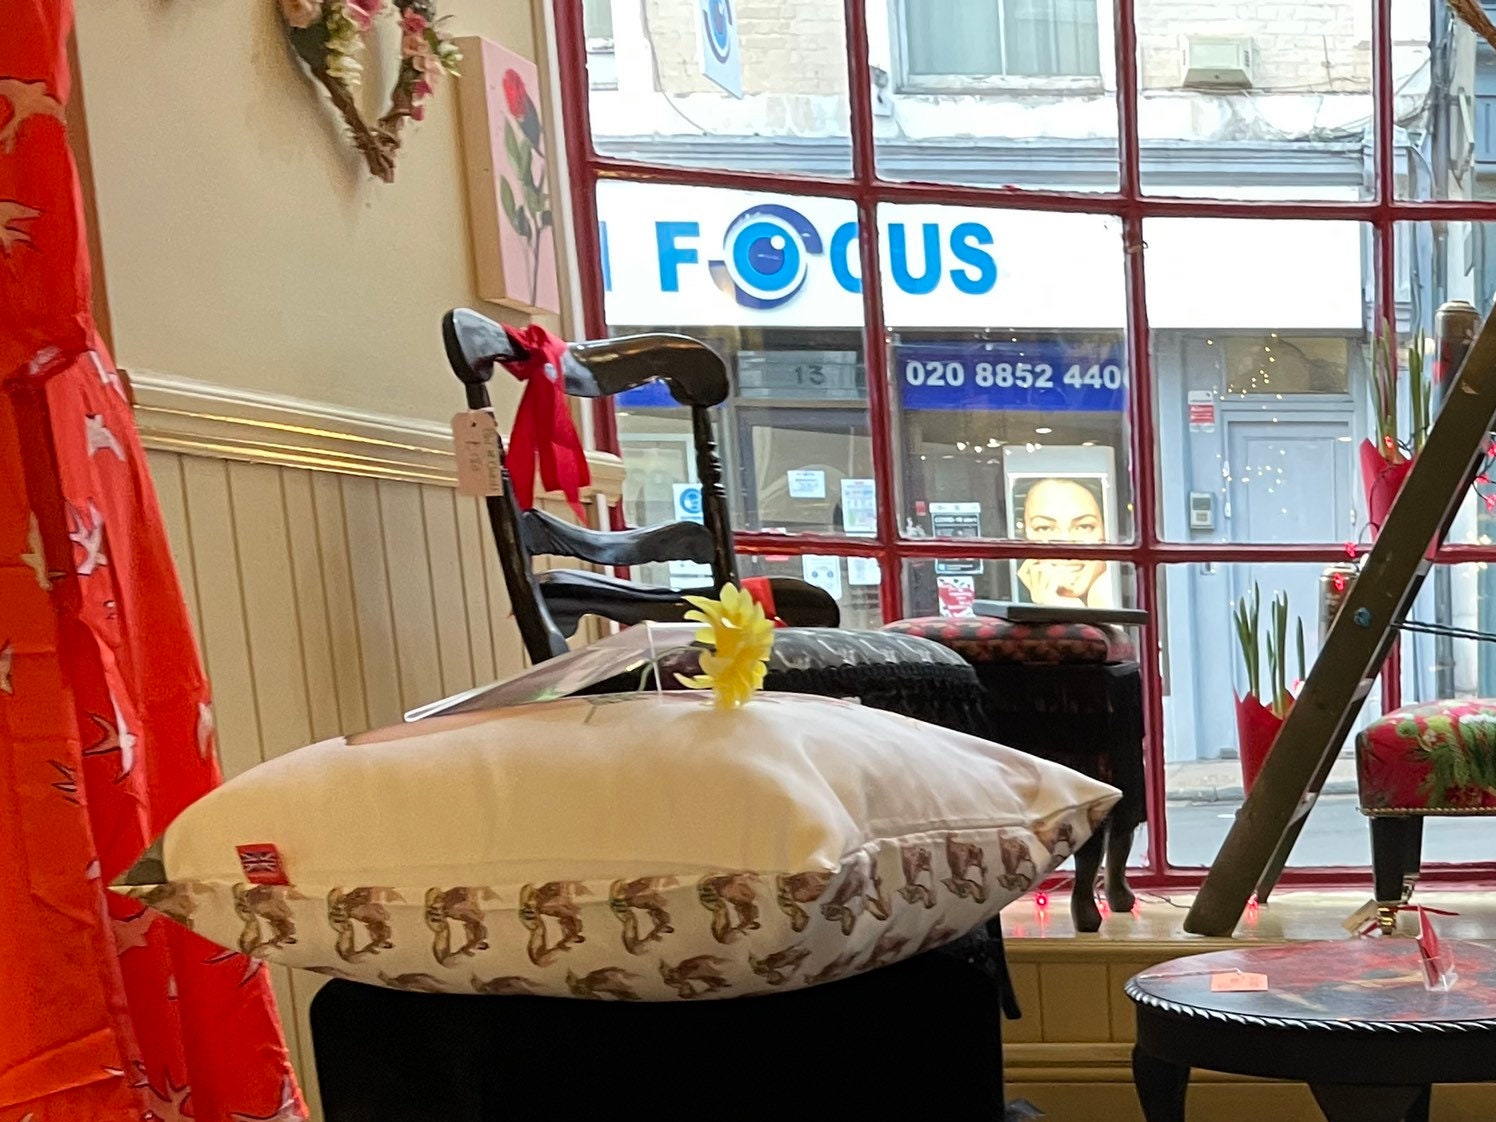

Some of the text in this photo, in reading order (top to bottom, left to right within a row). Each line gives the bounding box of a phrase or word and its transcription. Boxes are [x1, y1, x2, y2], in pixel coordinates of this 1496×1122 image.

[906, 361, 1129, 390] 020 8852 440
